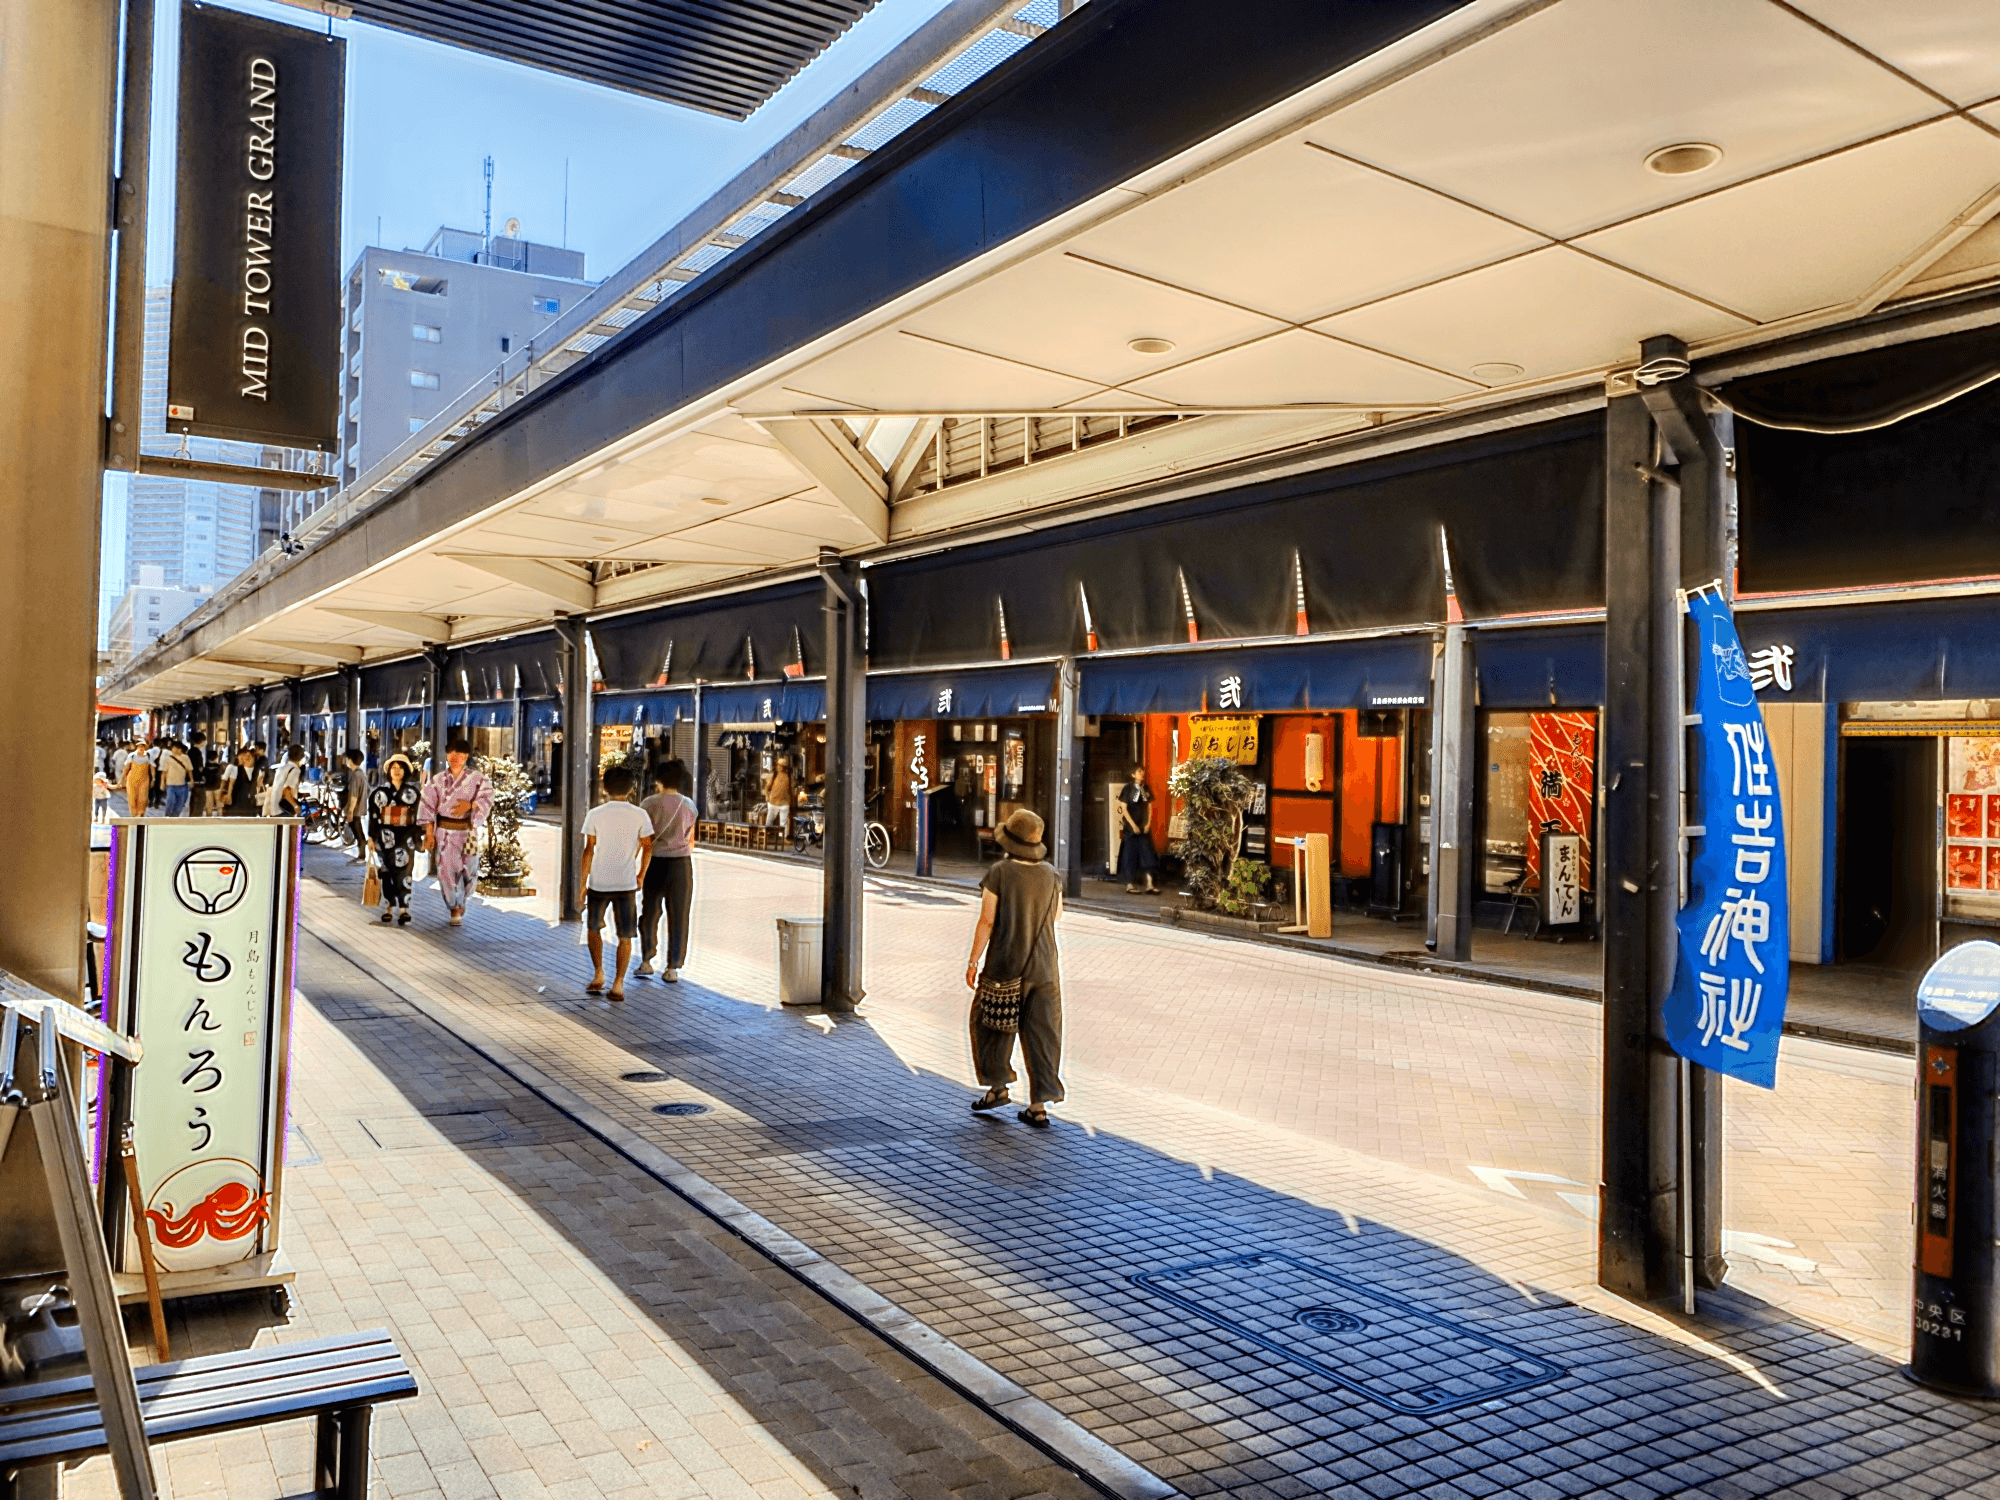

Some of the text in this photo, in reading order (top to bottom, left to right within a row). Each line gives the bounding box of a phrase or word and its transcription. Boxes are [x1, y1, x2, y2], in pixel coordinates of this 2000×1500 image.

[242, 58, 276, 401] MID TOWER GRAND
[1049, 698, 1059, 712] M
[1558, 844, 1576, 918] まんてん
[1697, 720, 1776, 1051] 住吉神社
[245, 930, 260, 1024] 月島もんじゃ
[182, 931, 232, 1151] もんろう
[1931, 1165, 1947, 1220] 消火器
[1914, 1298, 1967, 1326] 中央区
